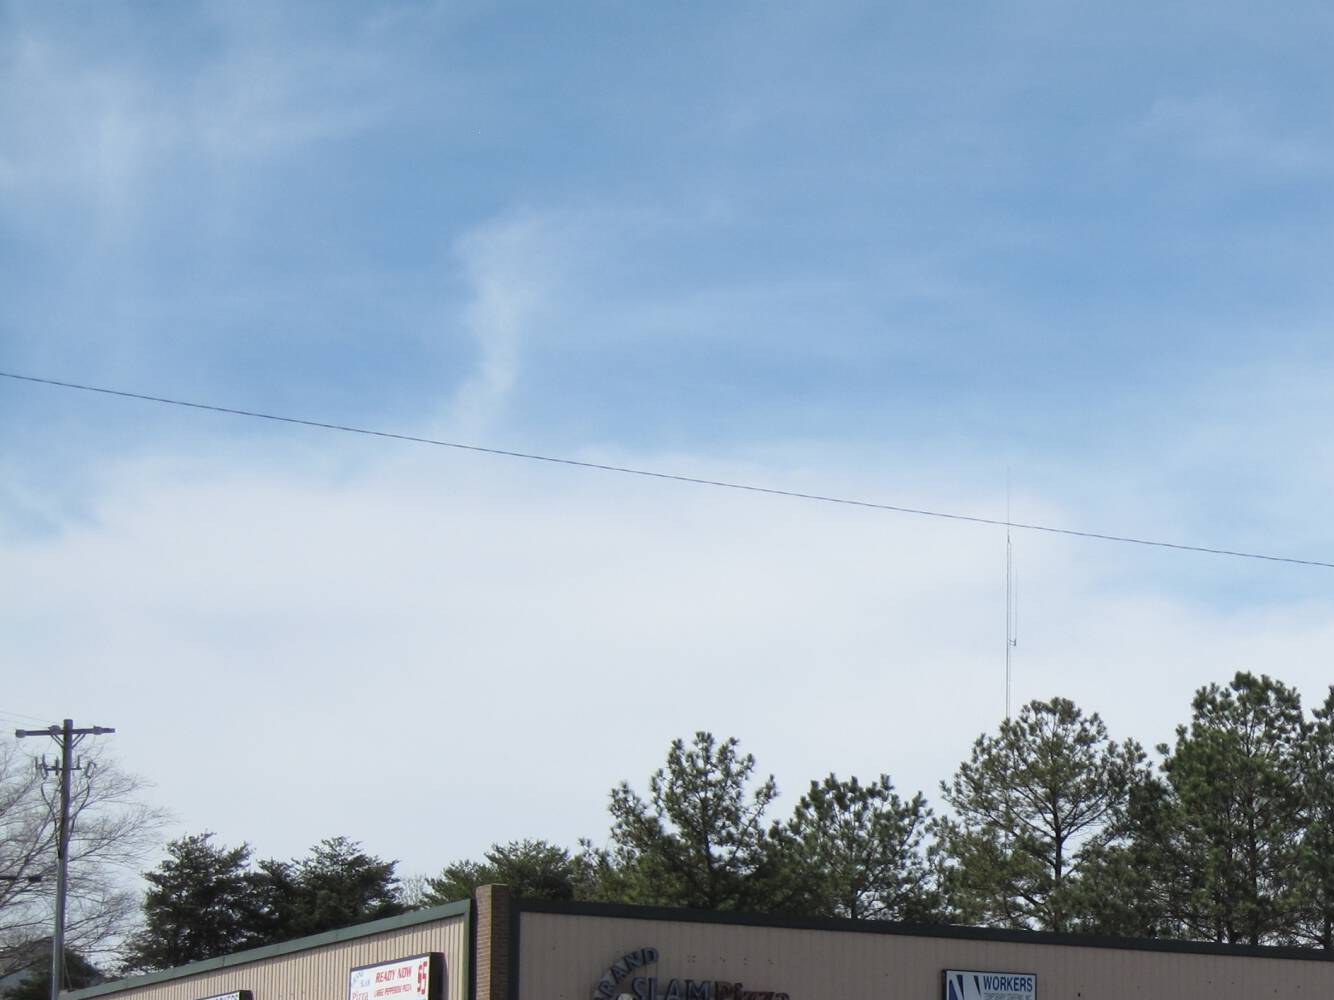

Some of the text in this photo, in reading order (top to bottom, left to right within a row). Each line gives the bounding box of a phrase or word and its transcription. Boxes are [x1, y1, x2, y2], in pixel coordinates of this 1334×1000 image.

[375, 970, 395, 983] READY
[398, 966, 412, 979] NOW
[983, 975, 1033, 992] WORKERS
